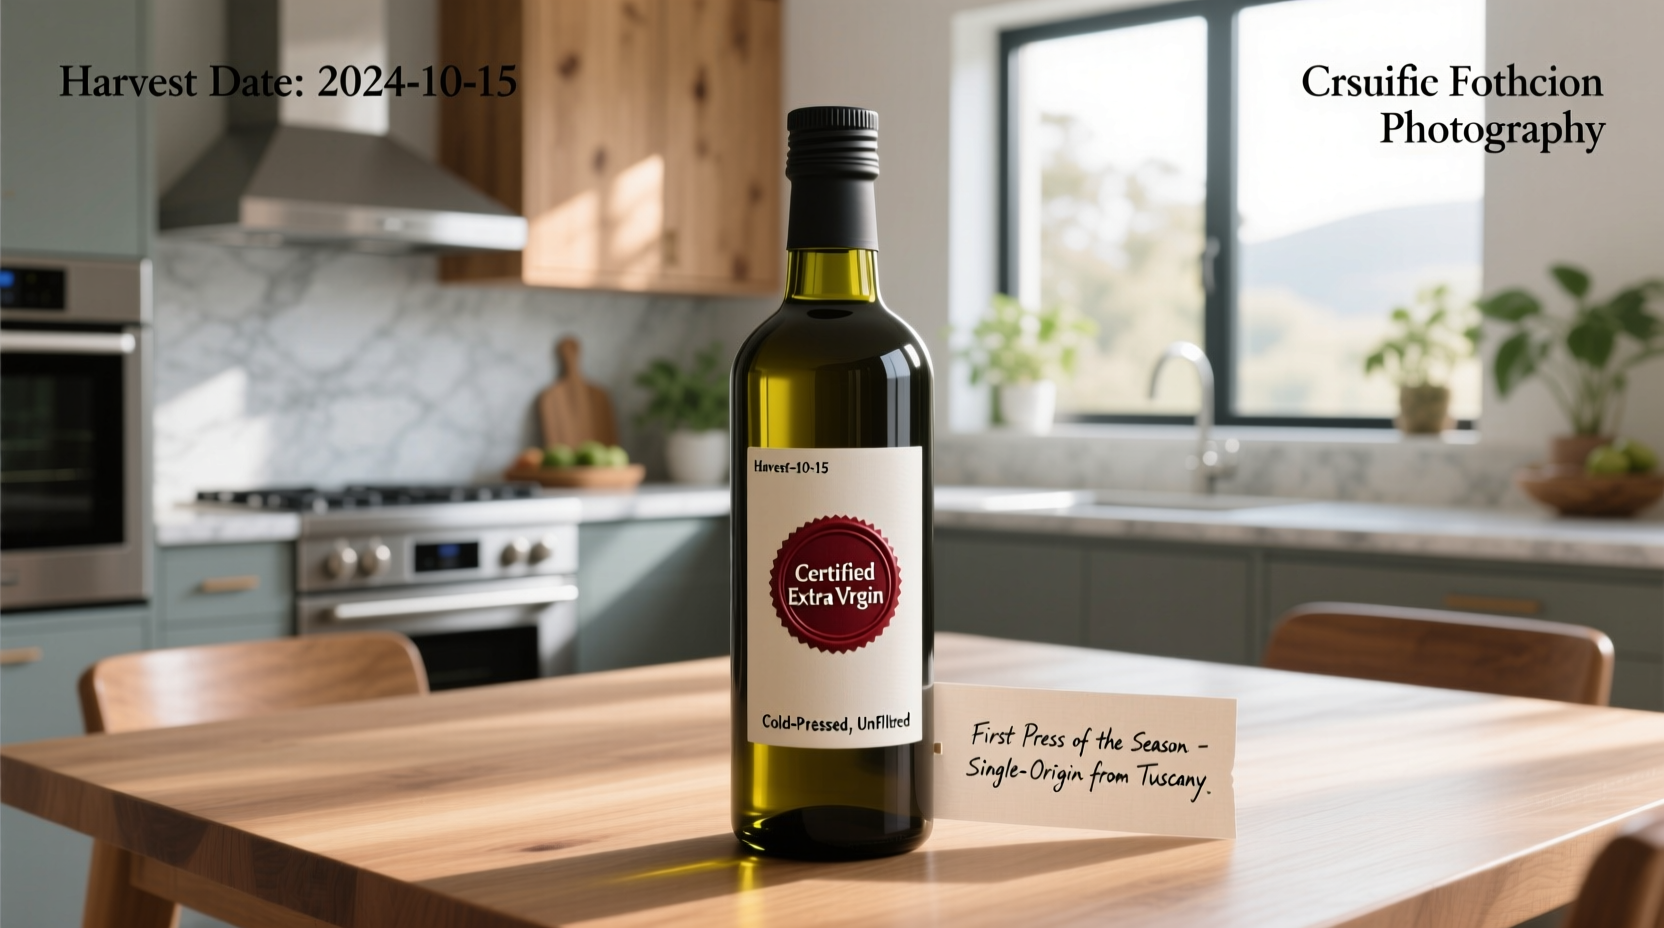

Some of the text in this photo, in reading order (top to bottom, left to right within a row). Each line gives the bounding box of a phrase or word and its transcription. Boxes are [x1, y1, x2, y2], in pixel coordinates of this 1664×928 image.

[794, 561, 876, 582] Certified
[787, 585, 884, 610] Extra Vrgin
[761, 713, 853, 736] Cold-Pressed,
[970, 720, 1016, 746] First
[1022, 722, 1066, 748] Press
[1072, 726, 1093, 757] of
[1095, 726, 1124, 751] the
[1130, 731, 1189, 754] Season
[965, 756, 1212, 803] Single-Origin from Tuscany.
